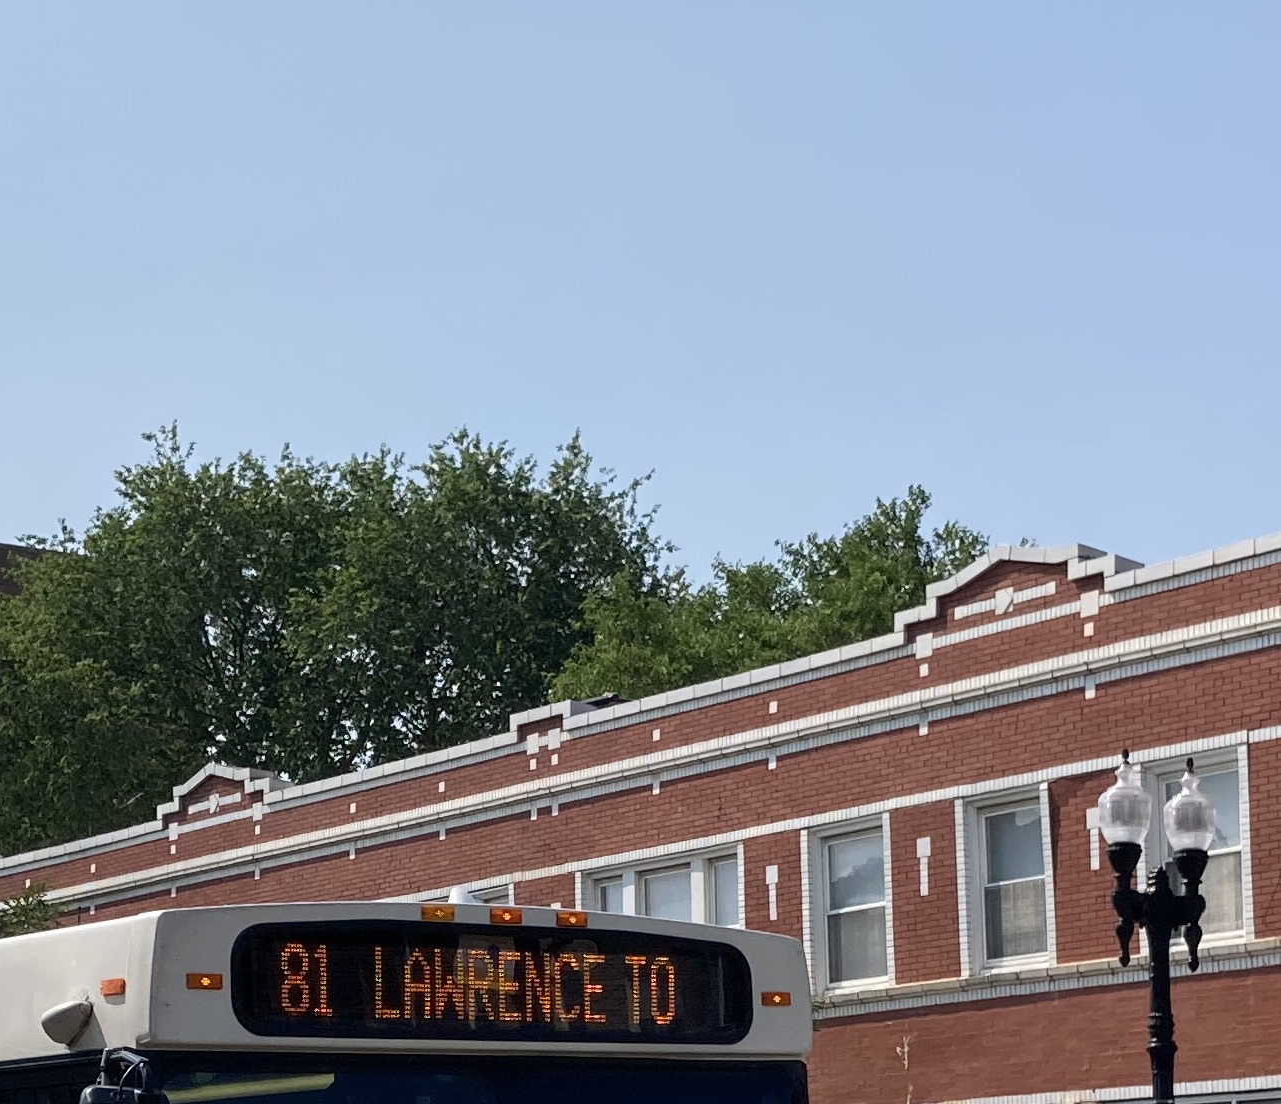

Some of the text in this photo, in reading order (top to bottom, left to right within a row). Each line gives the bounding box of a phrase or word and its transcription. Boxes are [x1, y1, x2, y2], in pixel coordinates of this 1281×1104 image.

[280, 943, 676, 1026] 81 LAWRENCE TO
